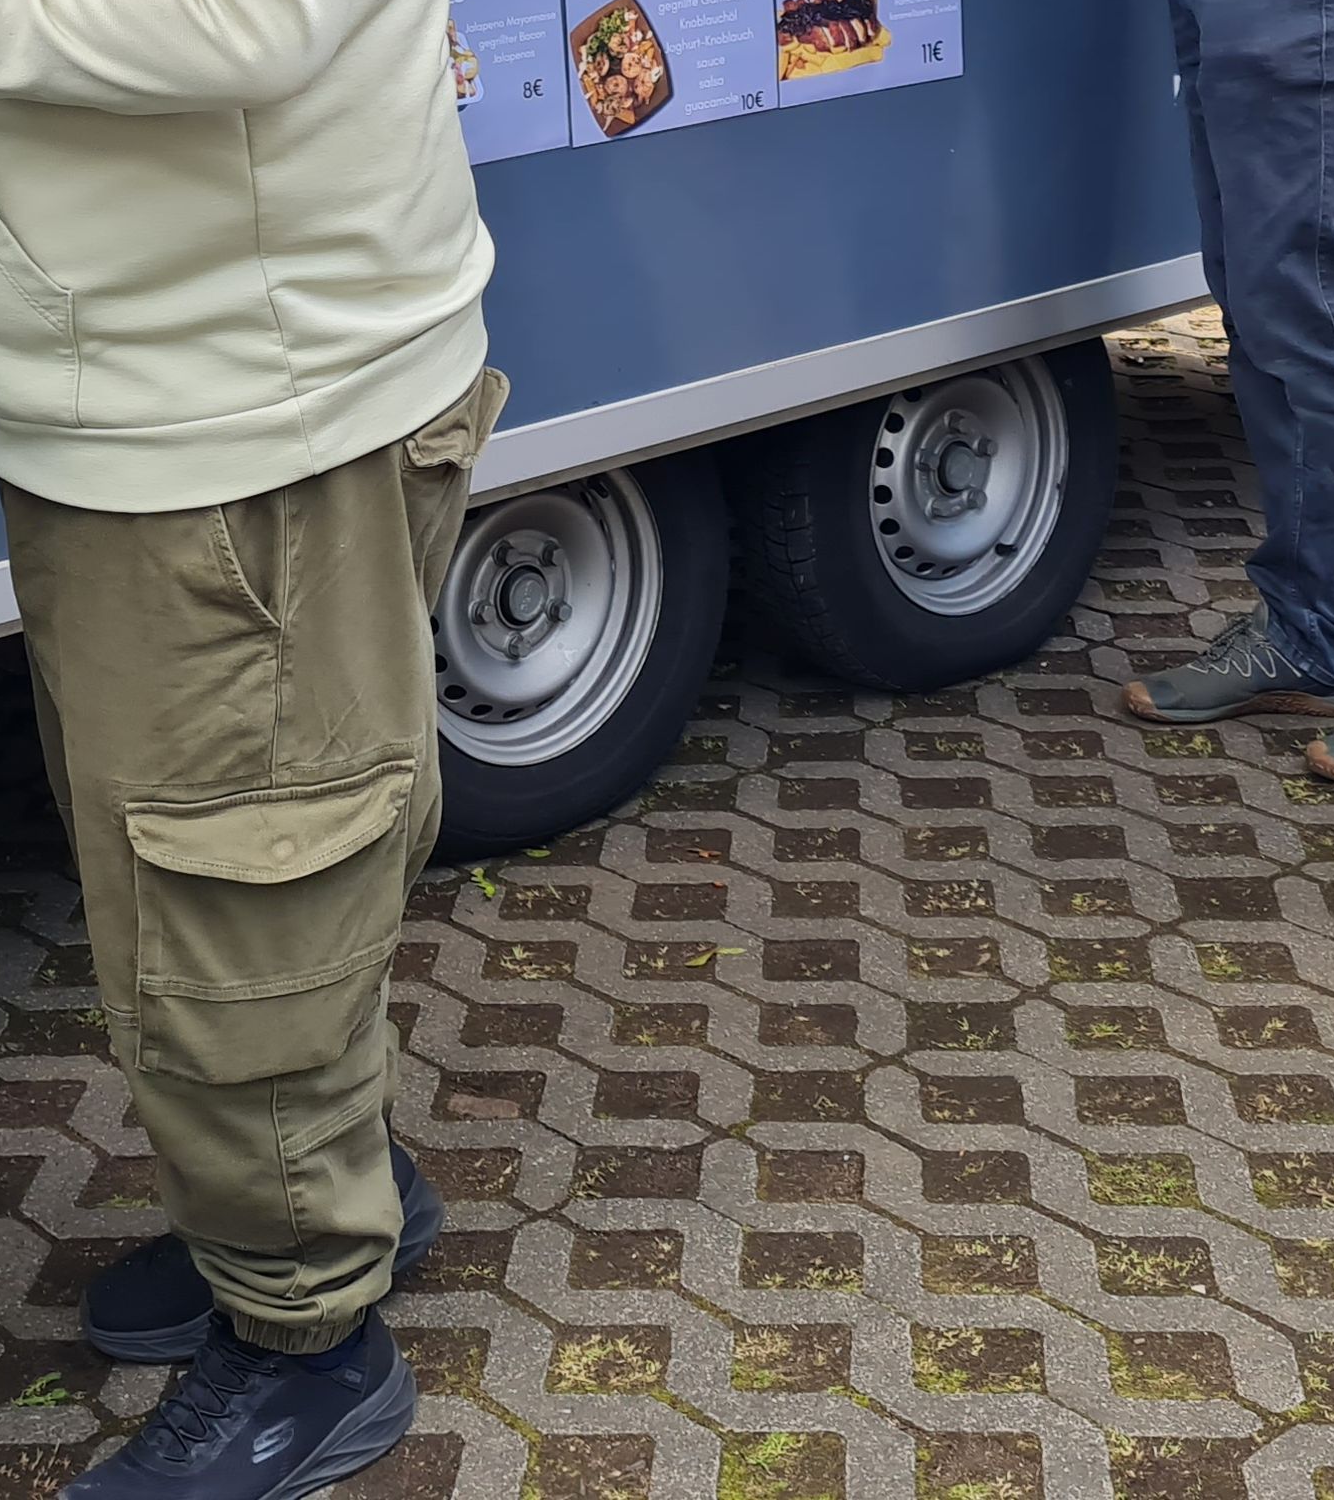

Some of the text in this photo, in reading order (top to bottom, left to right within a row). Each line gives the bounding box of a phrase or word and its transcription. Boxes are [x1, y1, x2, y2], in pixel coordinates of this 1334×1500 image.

[922, 40, 945, 64] 11€
[523, 79, 544, 99] 8€
[699, 75, 725, 90] salsa
[741, 91, 764, 110] 10€
